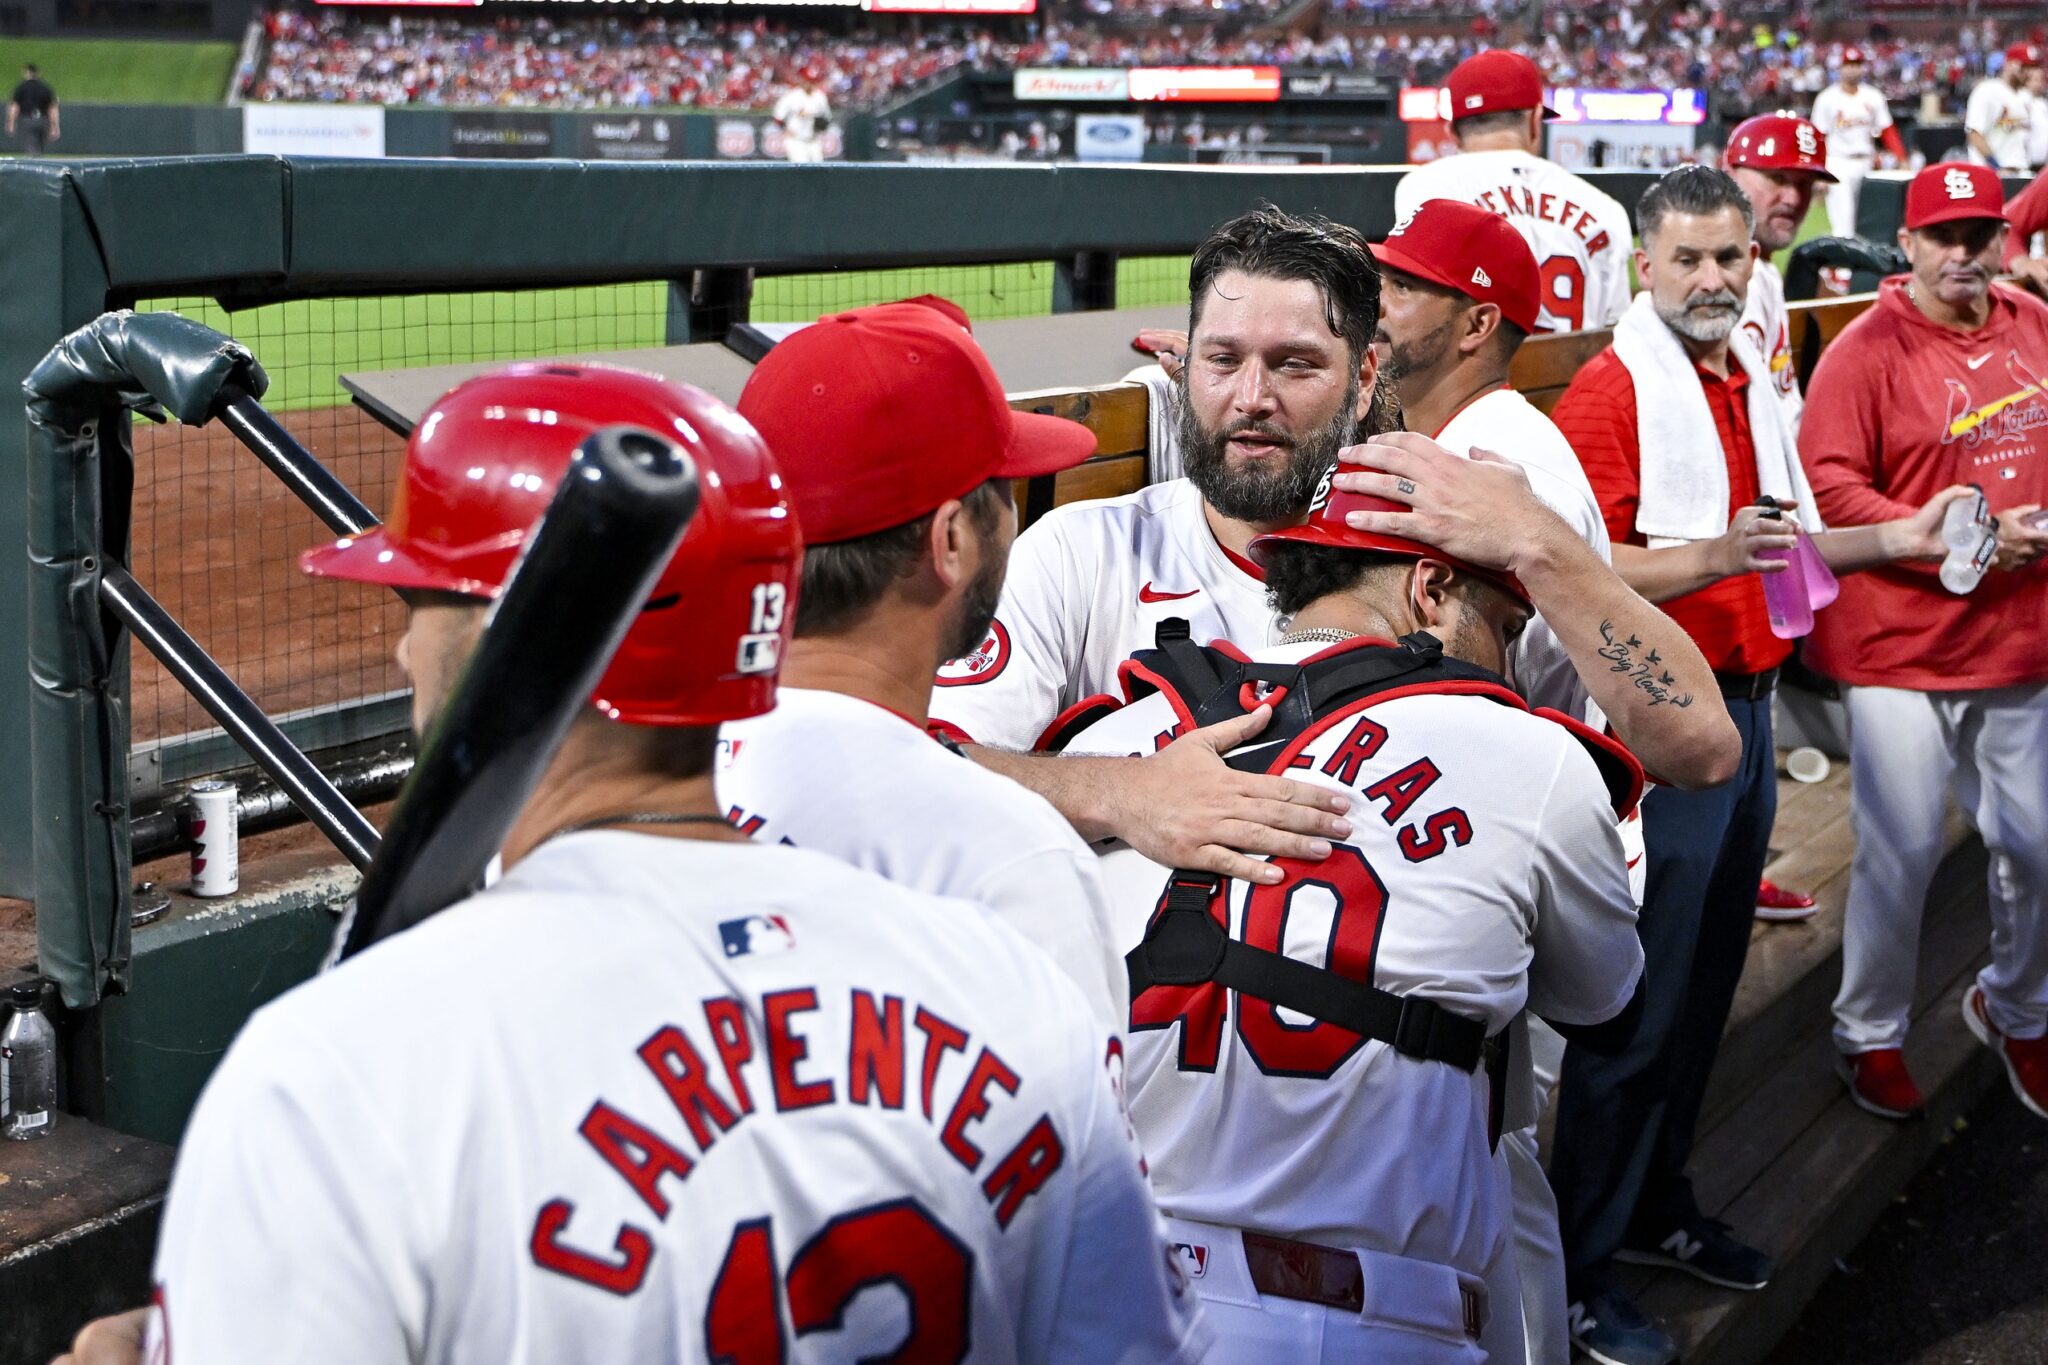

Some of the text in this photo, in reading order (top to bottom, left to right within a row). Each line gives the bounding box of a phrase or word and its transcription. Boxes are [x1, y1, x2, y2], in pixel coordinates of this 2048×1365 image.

[750, 581, 787, 635] 13
[1598, 643, 1633, 672] Big
[529, 984, 1066, 1298] CARPENTER
